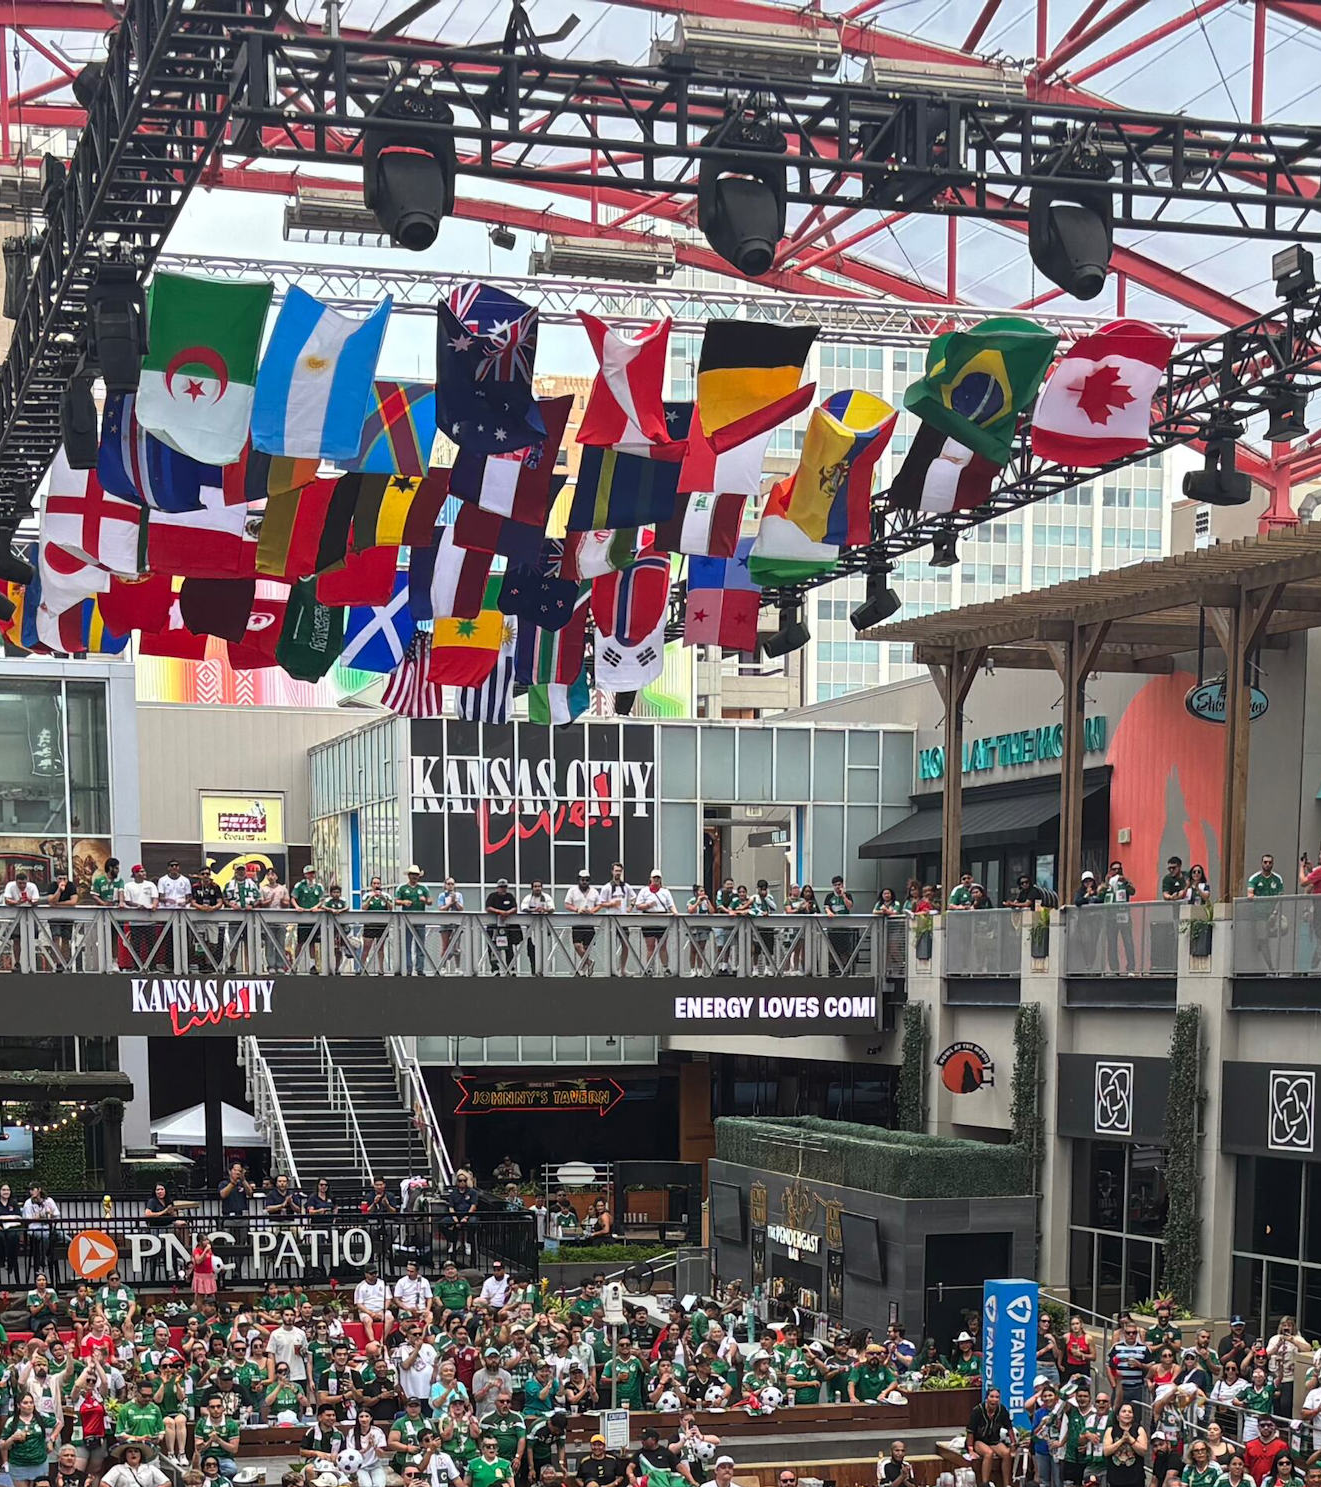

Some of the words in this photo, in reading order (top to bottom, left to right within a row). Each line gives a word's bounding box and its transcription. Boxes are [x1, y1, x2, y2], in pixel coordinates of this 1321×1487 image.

[1036, 715, 1107, 762] MON
[411, 755, 557, 816] KANSAS
[567, 760, 654, 818] CITY
[476, 771, 613, 856] Live!
[131, 978, 217, 1013] KANSAS
[223, 979, 275, 1013] CITY
[169, 987, 251, 1036] Live!
[674, 996, 753, 1019] ENERGY
[758, 996, 820, 1019] LOVES
[472, 1089, 549, 1107] JOHNNY'S
[552, 1088, 611, 1106] TAVERN
[248, 1227, 372, 1270] PATIO
[776, 1226, 820, 1254] PENDERGAST
[1009, 1328, 1026, 1421] FANDUEL
